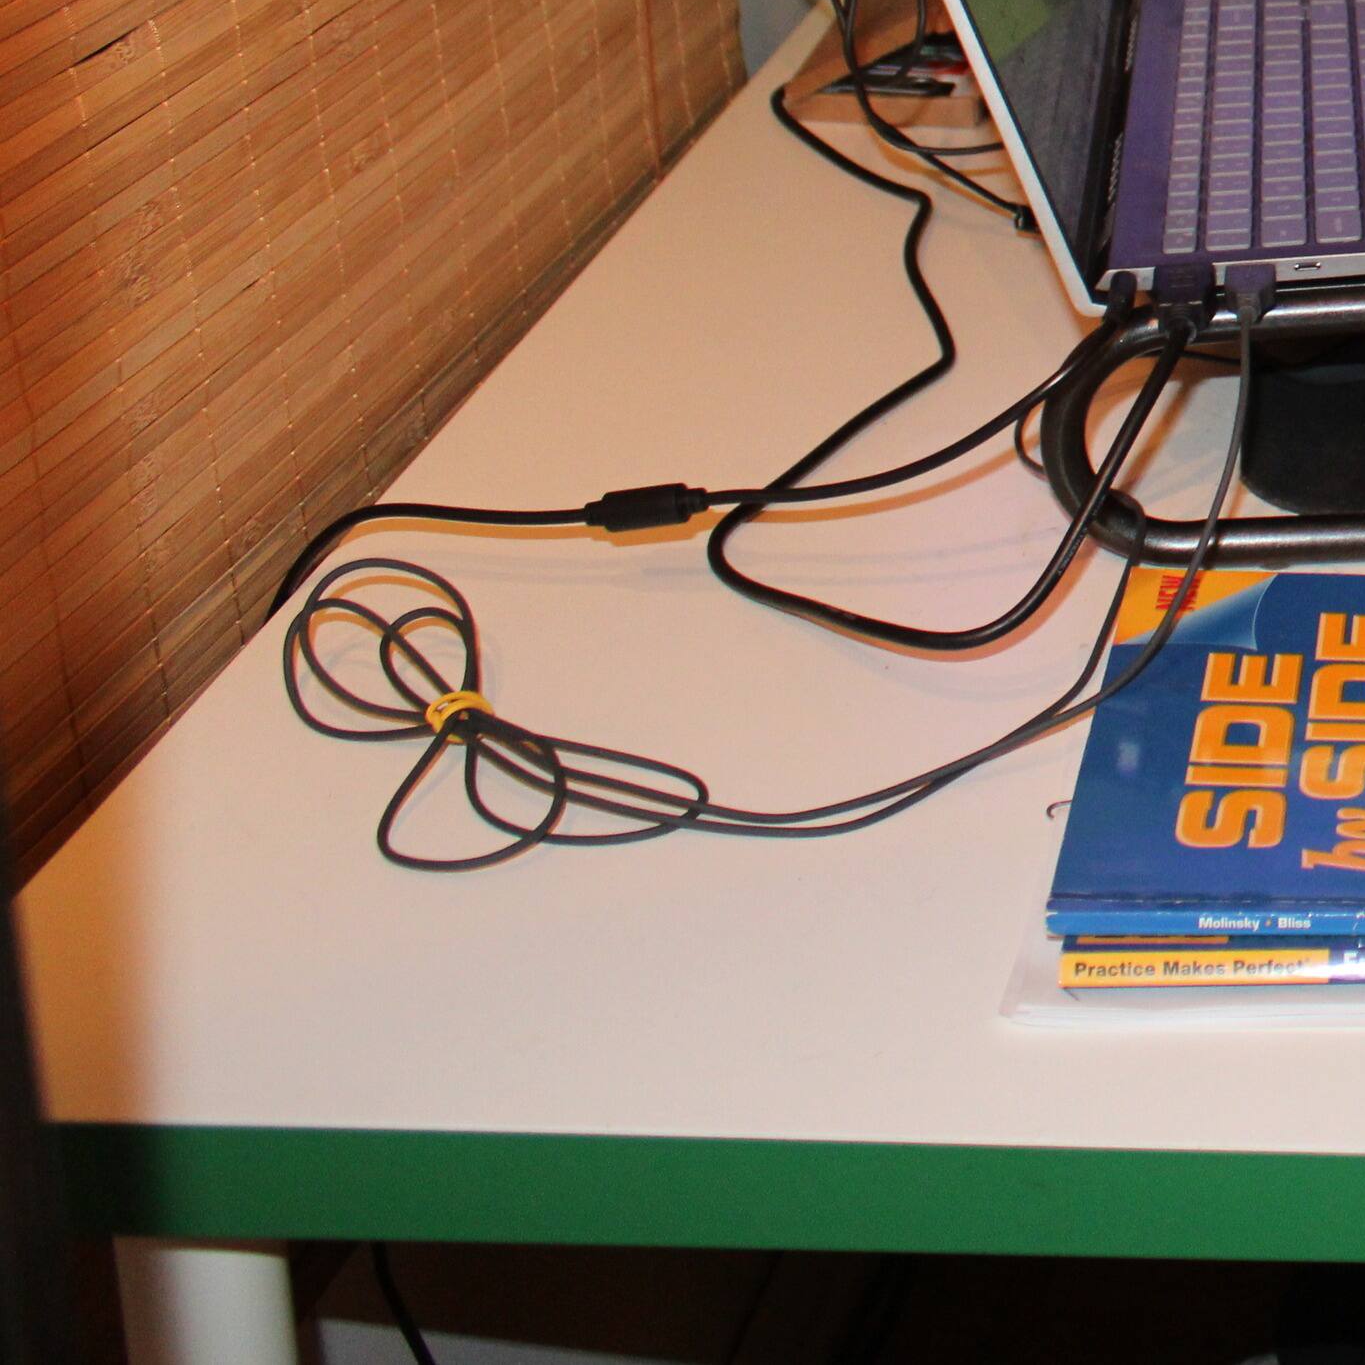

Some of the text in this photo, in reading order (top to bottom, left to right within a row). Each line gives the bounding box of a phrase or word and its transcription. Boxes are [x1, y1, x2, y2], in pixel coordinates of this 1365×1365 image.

[1175, 652, 1304, 849] SIDE
[1198, 917, 1312, 931] Molinsky Bliss
[1074, 961, 1156, 977] Practice
[1163, 960, 1226, 976] Makes
